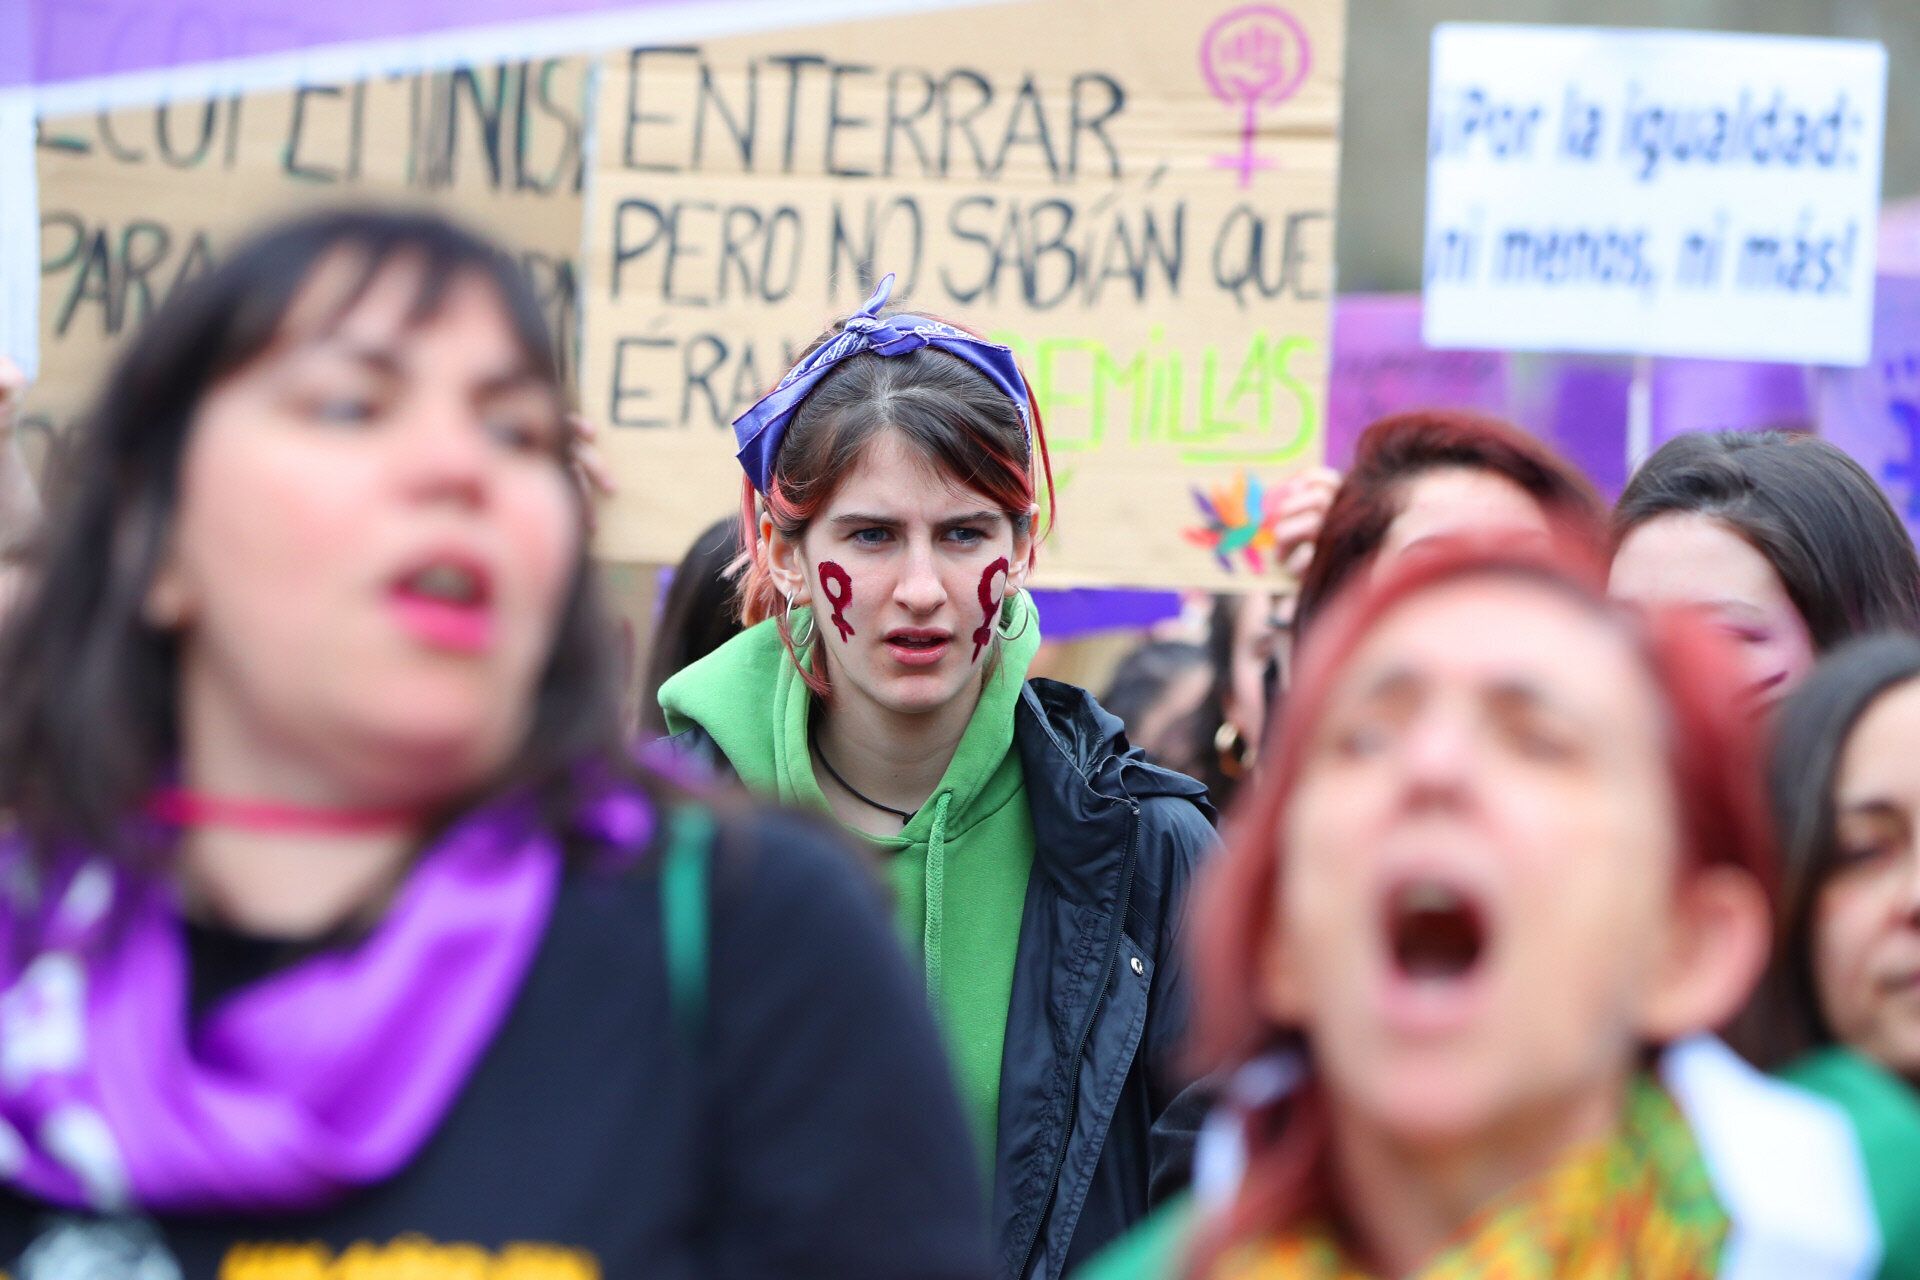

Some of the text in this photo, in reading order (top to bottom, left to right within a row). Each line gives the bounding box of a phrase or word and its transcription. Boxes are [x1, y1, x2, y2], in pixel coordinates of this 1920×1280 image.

[1560, 82, 1603, 161] la
[610, 198, 803, 306] PERO
[828, 195, 923, 306] NO
[1211, 203, 1332, 312] QUE
[1676, 208, 1728, 286] ni
